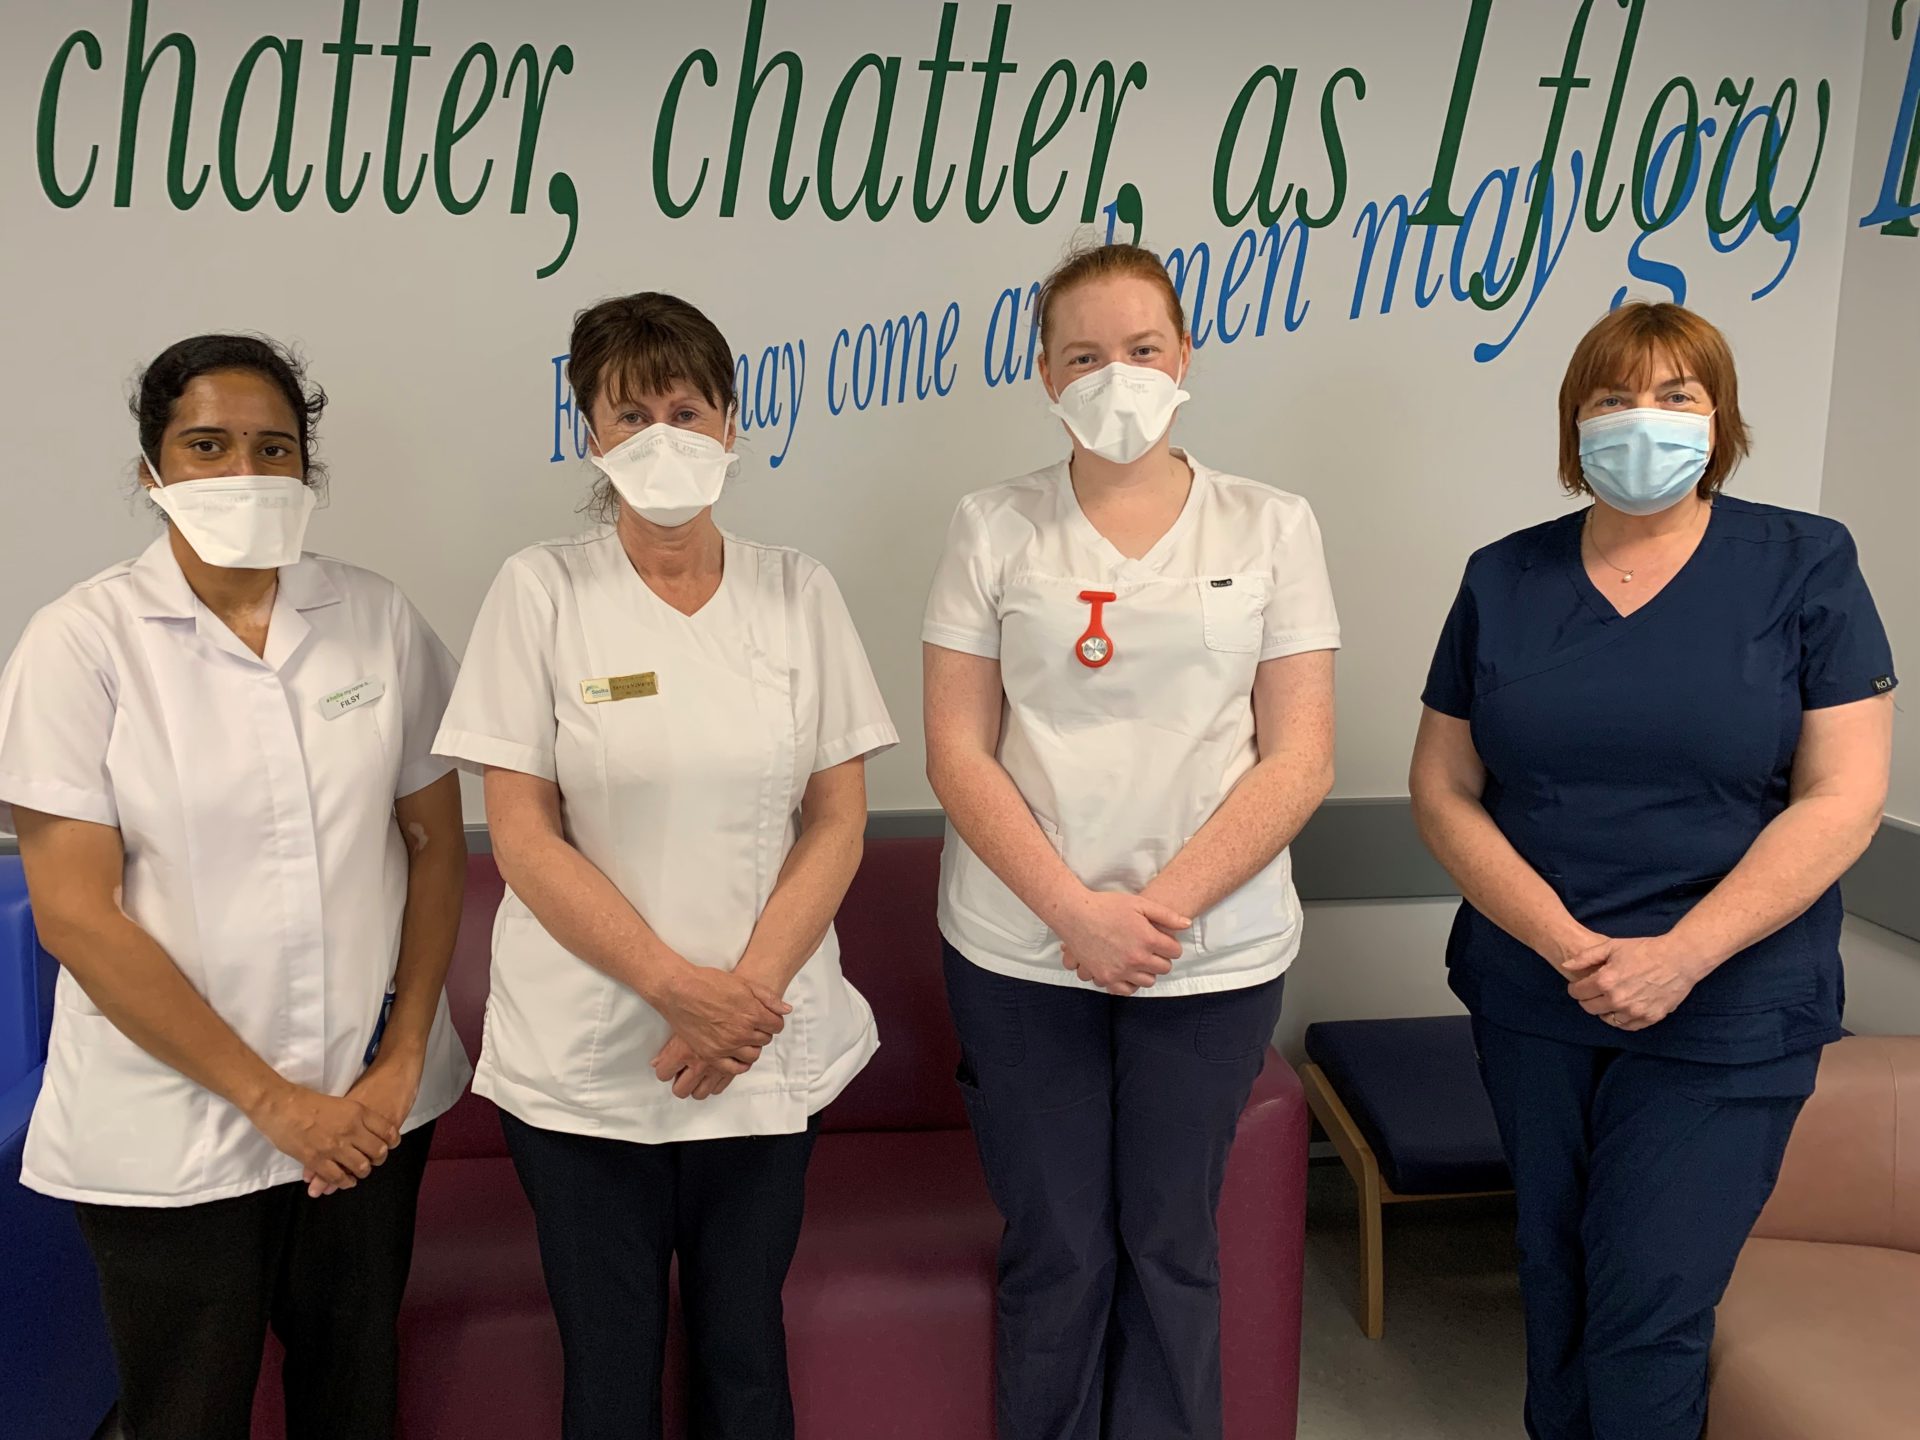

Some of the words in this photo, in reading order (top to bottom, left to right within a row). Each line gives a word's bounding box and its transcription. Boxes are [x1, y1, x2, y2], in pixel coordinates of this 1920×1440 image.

[36, 0, 579, 280] chatter,
[652, 0, 1148, 248] chatter,
[1212, 64, 1366, 229] as
[1406, 0, 1495, 227] I
[1469, 0, 1831, 312] flow
[550, 353, 588, 463] Fo
[826, 300, 961, 416] come
[1349, 149, 1584, 364] may
[1609, 105, 1801, 311] go,
[340, 693, 360, 709] FILSY
